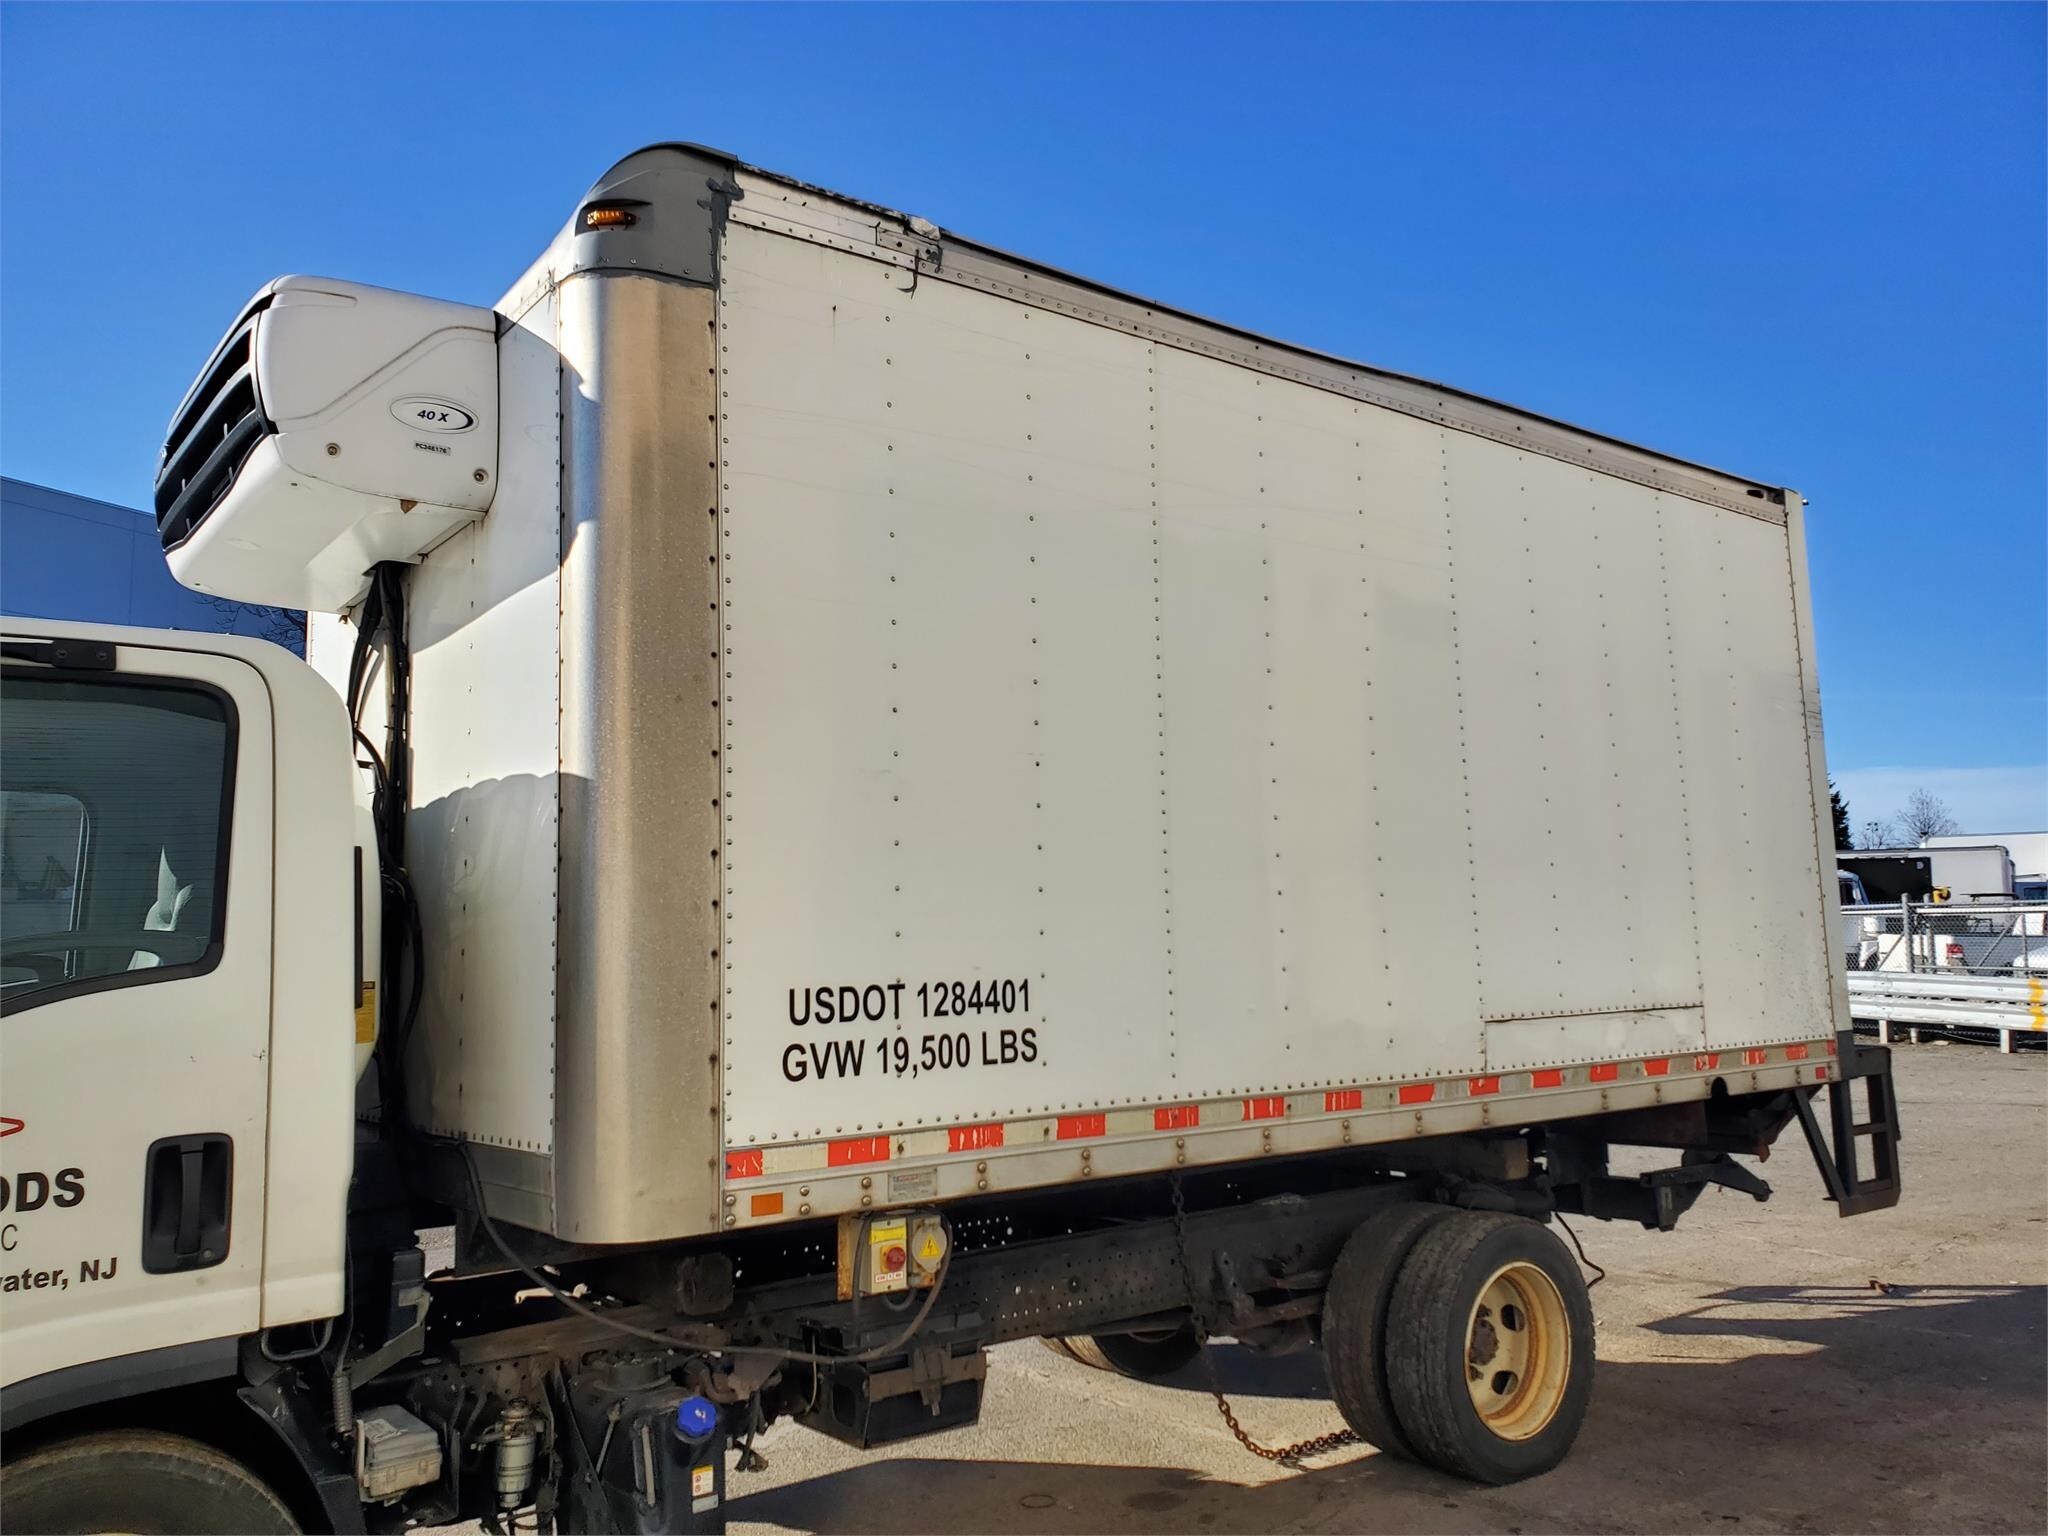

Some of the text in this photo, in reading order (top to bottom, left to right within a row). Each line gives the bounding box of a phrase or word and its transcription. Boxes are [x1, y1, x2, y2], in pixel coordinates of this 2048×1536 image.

[417, 409, 450, 423] 40 X
[788, 978, 1030, 1026] USDOT 1284401
[782, 1027, 1038, 1082] GVW 19,500 LBS
[0, 1167, 86, 1213] DS
[0, 1257, 118, 1293] ater, NJ
